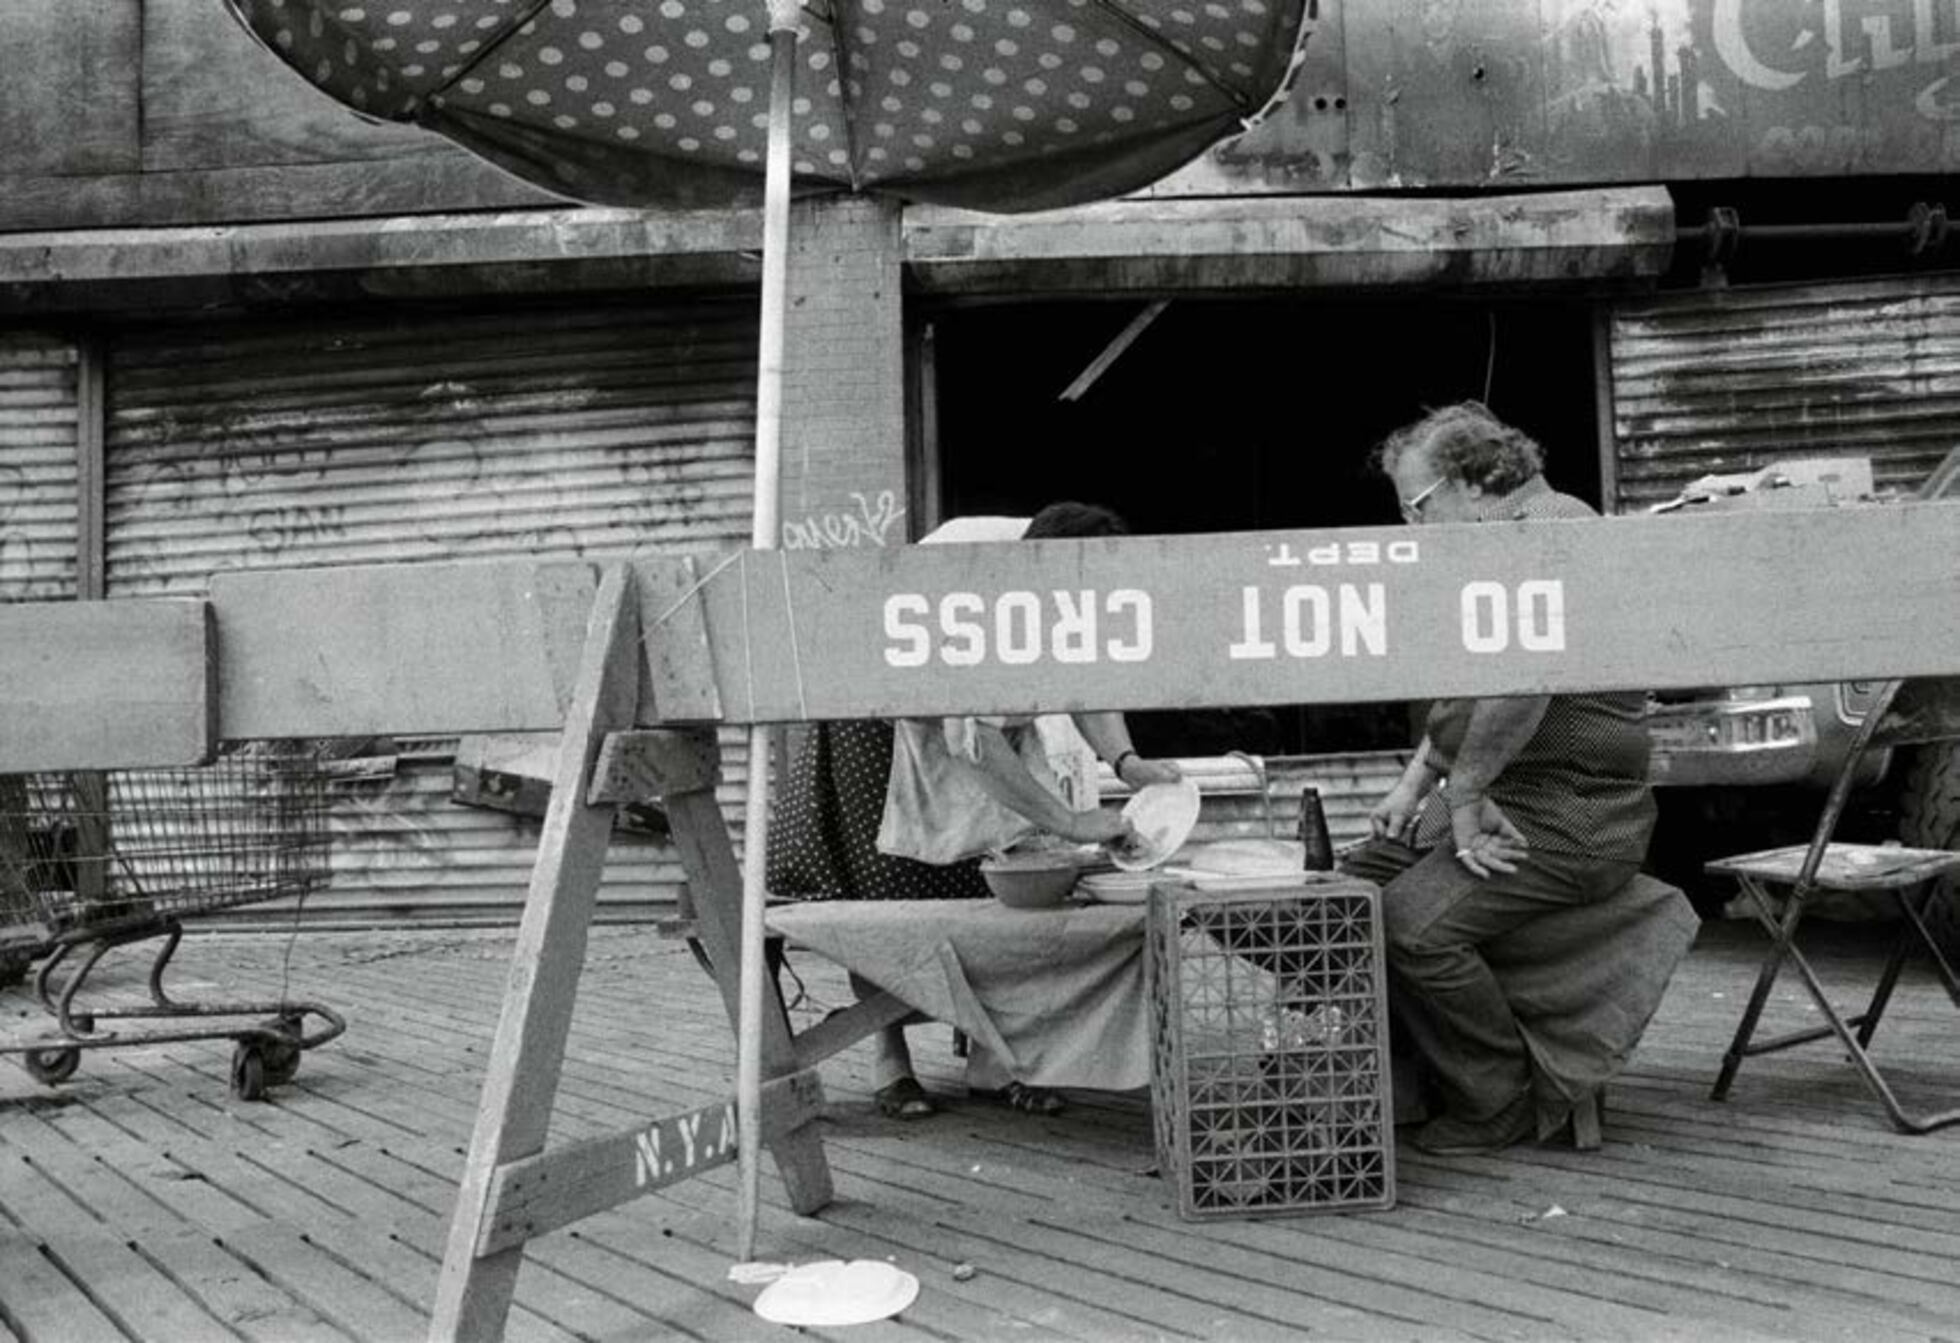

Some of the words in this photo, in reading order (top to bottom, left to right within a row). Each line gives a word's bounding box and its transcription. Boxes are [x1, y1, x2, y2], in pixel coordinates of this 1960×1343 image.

[1264, 540, 1419, 566] DEPT.
[883, 588, 1153, 668] CROSS
[1229, 582, 1388, 660] NOT
[1460, 579, 1566, 654] DO
